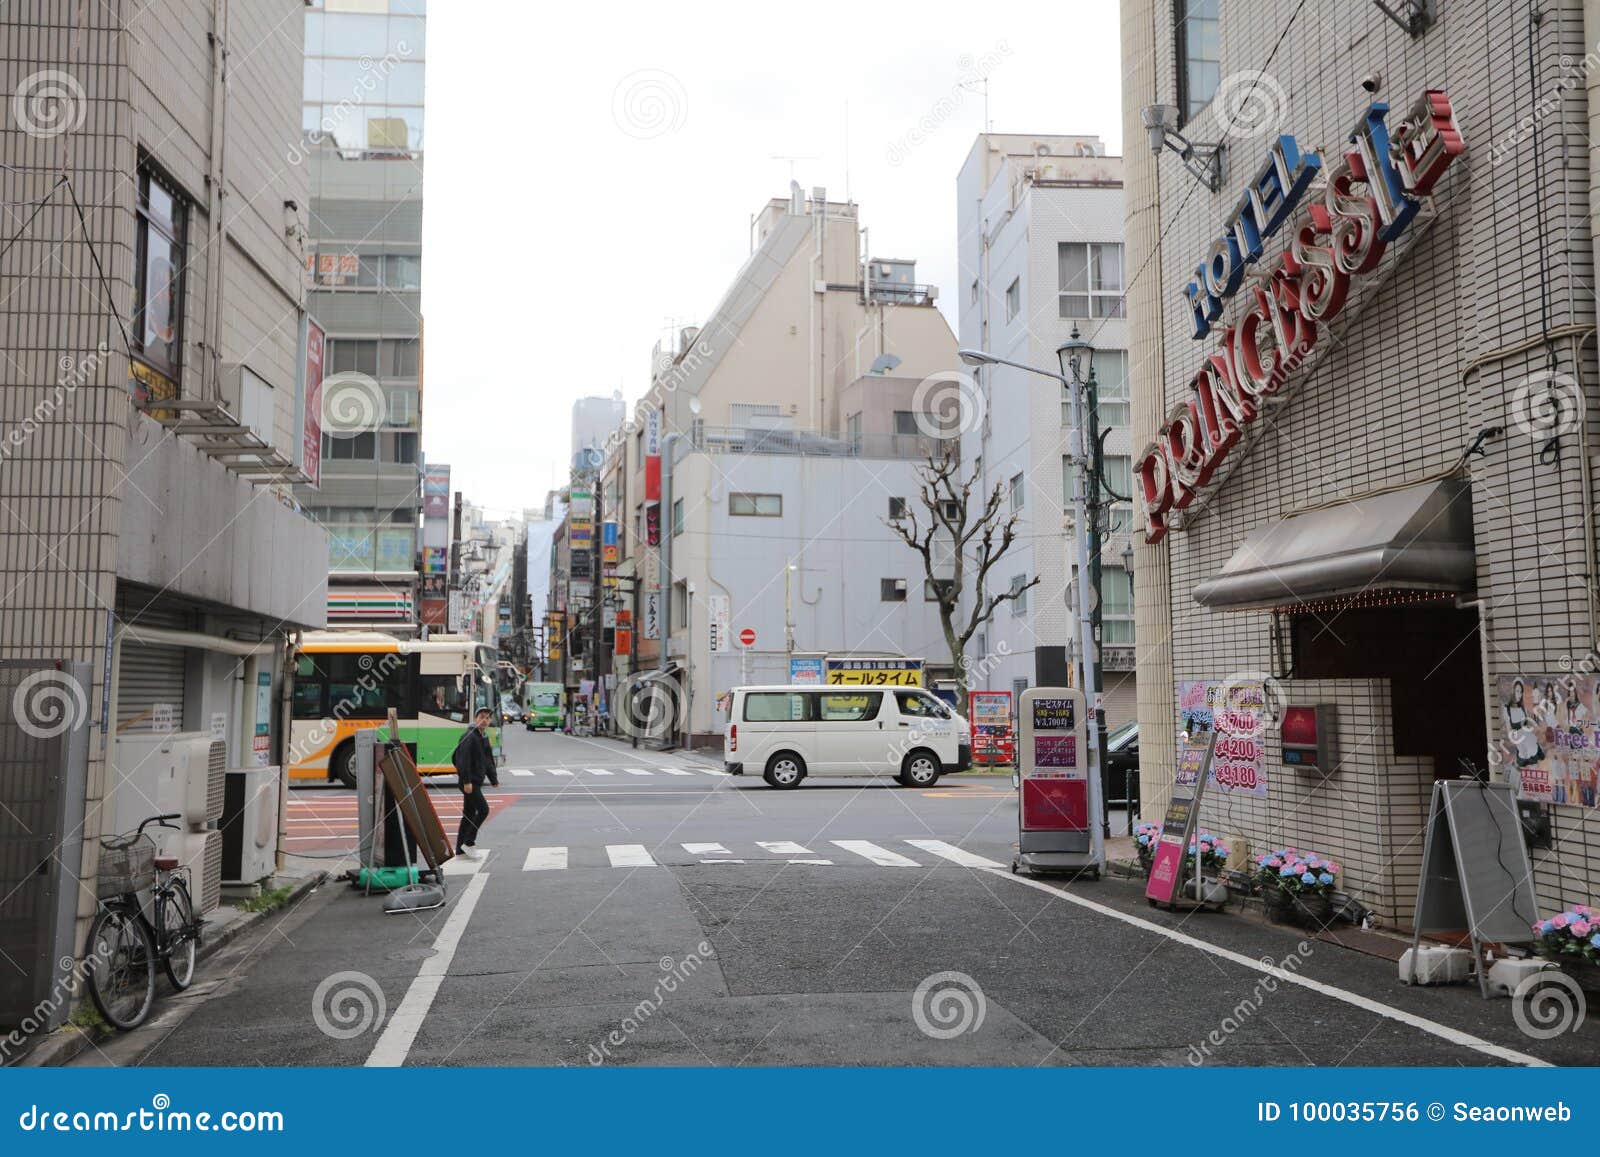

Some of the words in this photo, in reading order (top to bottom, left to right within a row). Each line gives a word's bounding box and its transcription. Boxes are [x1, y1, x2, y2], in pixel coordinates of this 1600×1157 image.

[1183, 134, 1321, 341] HOTEL
[832, 672, 918, 685] オールタイム
[1035, 700, 1072, 709] サービスタイム
[1576, 719, 1600, 729] フリー
[1553, 727, 1589, 748] Free
